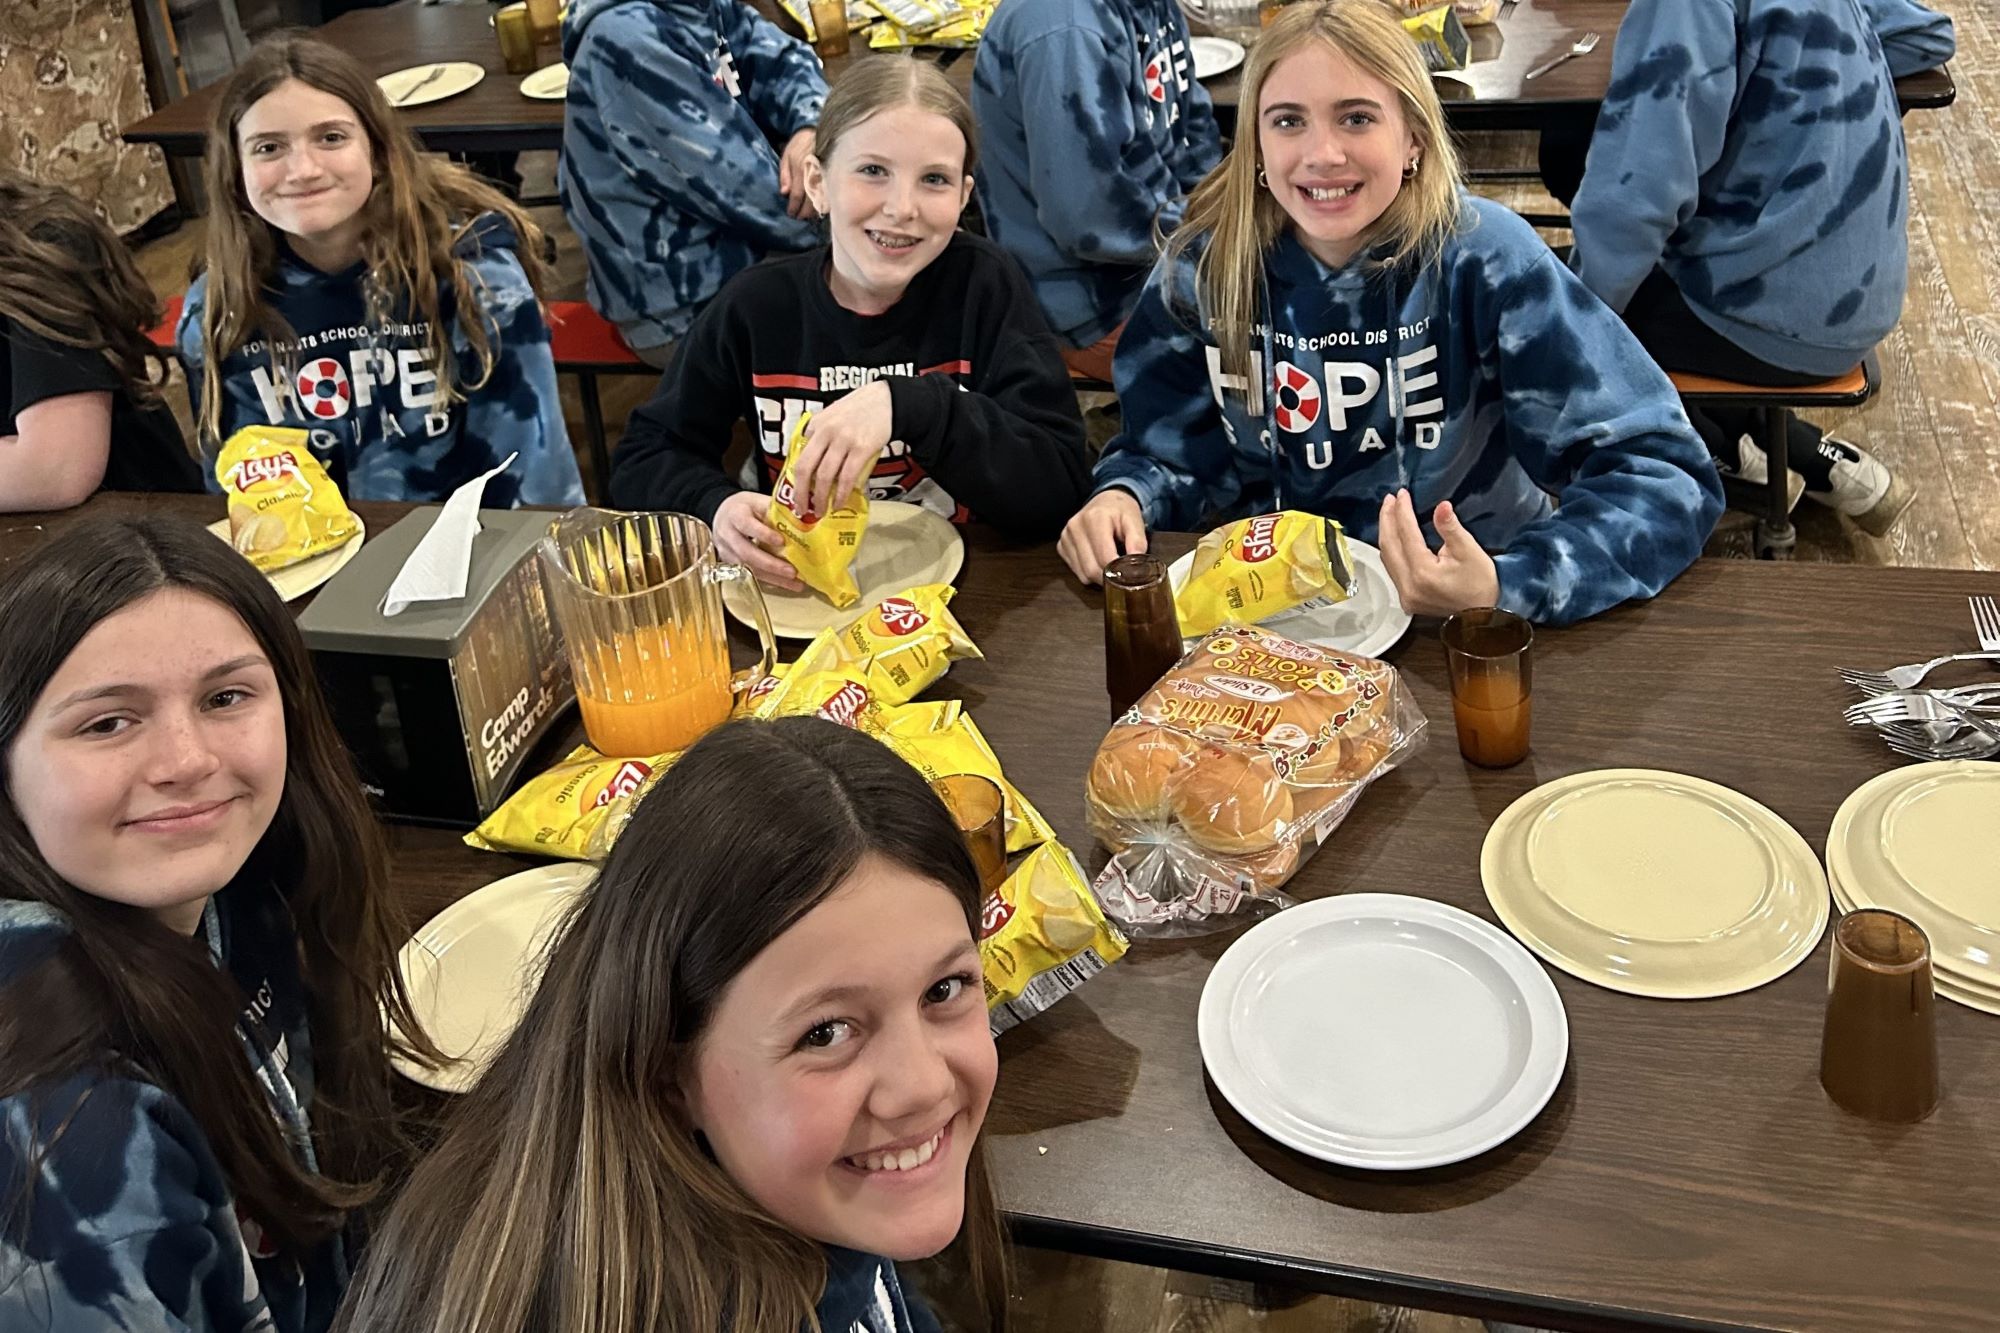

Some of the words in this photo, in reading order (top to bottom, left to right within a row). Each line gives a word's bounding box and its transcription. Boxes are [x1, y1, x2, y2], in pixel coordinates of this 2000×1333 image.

[320, 325, 377, 344] SCHOO
[383, 321, 430, 336] DIRICT
[1298, 331, 1360, 351] SCHOOL
[1365, 316, 1431, 345] DISRICT
[251, 348, 438, 425] HOPE
[1205, 344, 1444, 434] HOPE
[310, 406, 450, 449] QUAD
[1817, 441, 1844, 462] IKE
[238, 450, 297, 491] Lay's
[849, 623, 871, 654] Classic
[1212, 656, 1318, 694] POTATO
[1237, 648, 1316, 675] ROLLS
[1212, 675, 1251, 693] Slider
[1249, 685, 1272, 698] 12
[481, 686, 529, 749] Camp
[486, 685, 554, 780] Edwards
[1160, 698, 1282, 741] Martin's
[554, 763, 599, 805] Classic
[922, 764, 952, 797] assic
[1056, 966, 1075, 987] Calories
